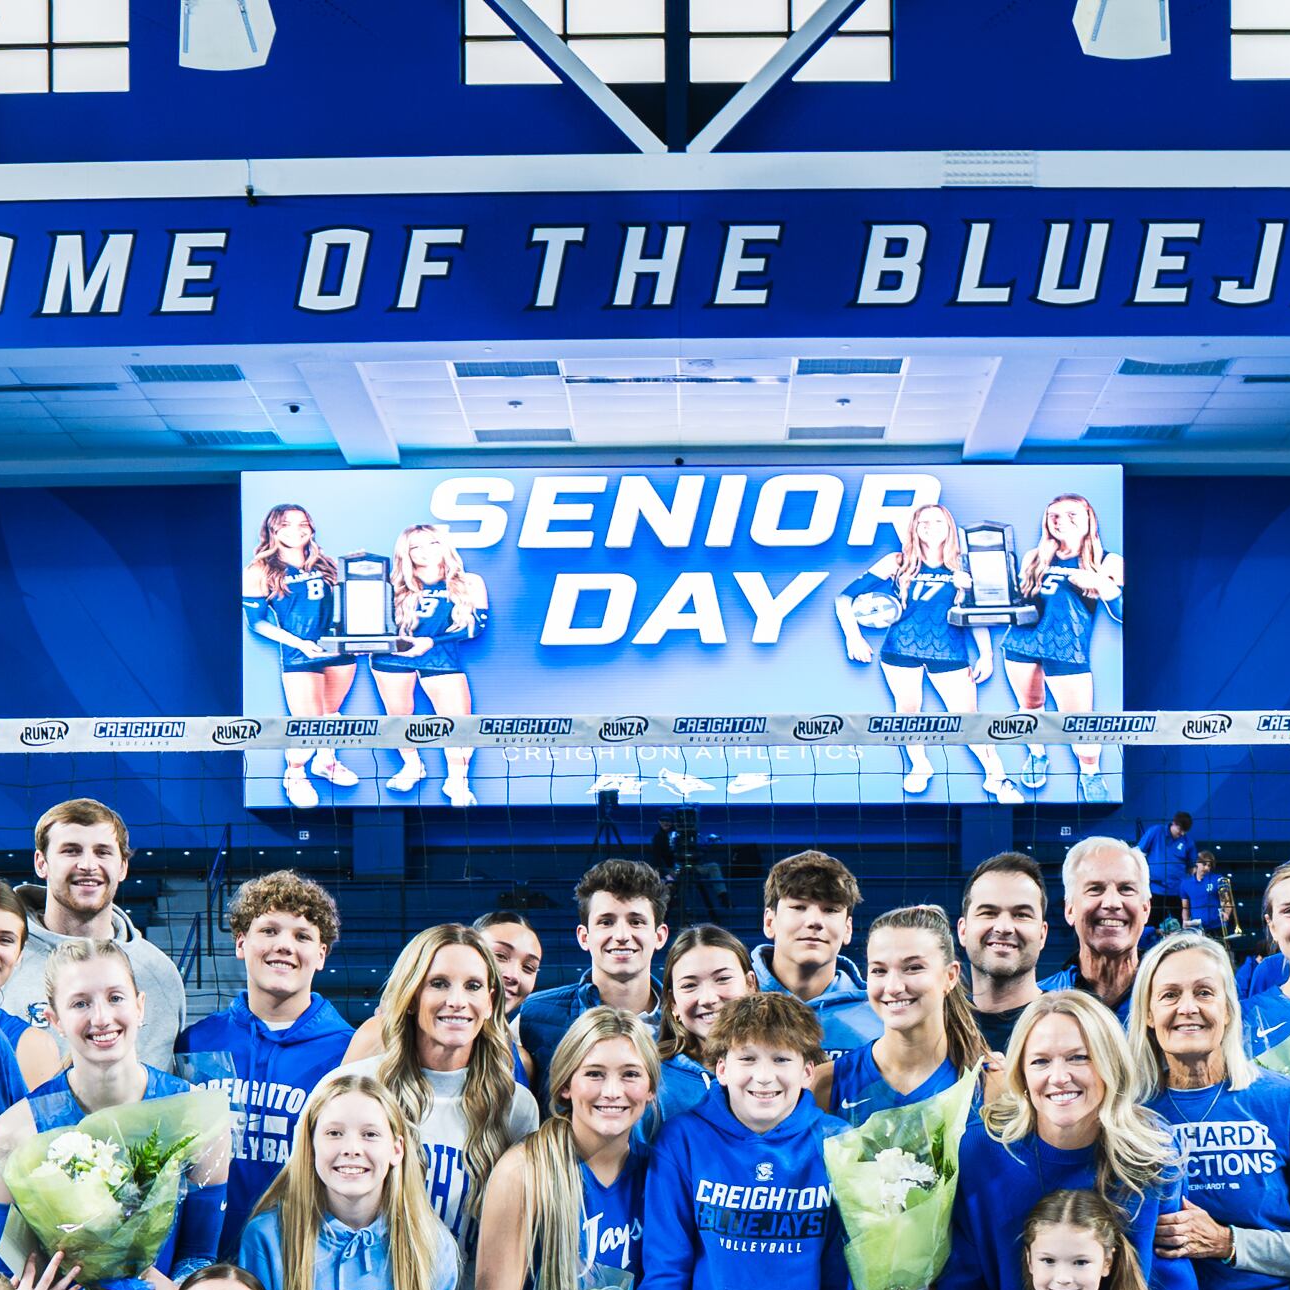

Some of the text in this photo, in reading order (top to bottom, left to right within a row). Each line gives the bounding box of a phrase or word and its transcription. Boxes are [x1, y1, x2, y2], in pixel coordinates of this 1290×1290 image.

[295, 225, 466, 313] OF
[526, 221, 784, 310] THE
[429, 474, 942, 549] SENIOR
[307, 578, 325, 600] 8
[912, 581, 945, 601] 17
[1040, 575, 1065, 600] 5
[540, 571, 830, 646] DAY
[94, 722, 185, 738] CREIGHTON
[216, 724, 258, 739] RUNZA
[285, 720, 378, 736] CREIGHTON
[409, 723, 450, 738] RUNZA
[479, 719, 571, 735] CREIGHTON
[603, 721, 645, 736] RUNZA
[673, 718, 766, 734] CREIGHTON
[797, 720, 840, 735] RUNZA
[867, 717, 960, 733] CREIGHTON
[992, 718, 1034, 734] RUNZA
[1062, 717, 1154, 732] CREIGHTON
[1186, 718, 1228, 733] RUNZA
[24, 726, 65, 741] RUNZA
[501, 745, 864, 761] CREIGHTON ATHLETICS
[696, 1180, 836, 1210] CREIGHTON
[701, 1207, 824, 1236] BLUEJAYS
[577, 1212, 643, 1277] Jays
[720, 1237, 802, 1253] VOLLEYBALL
